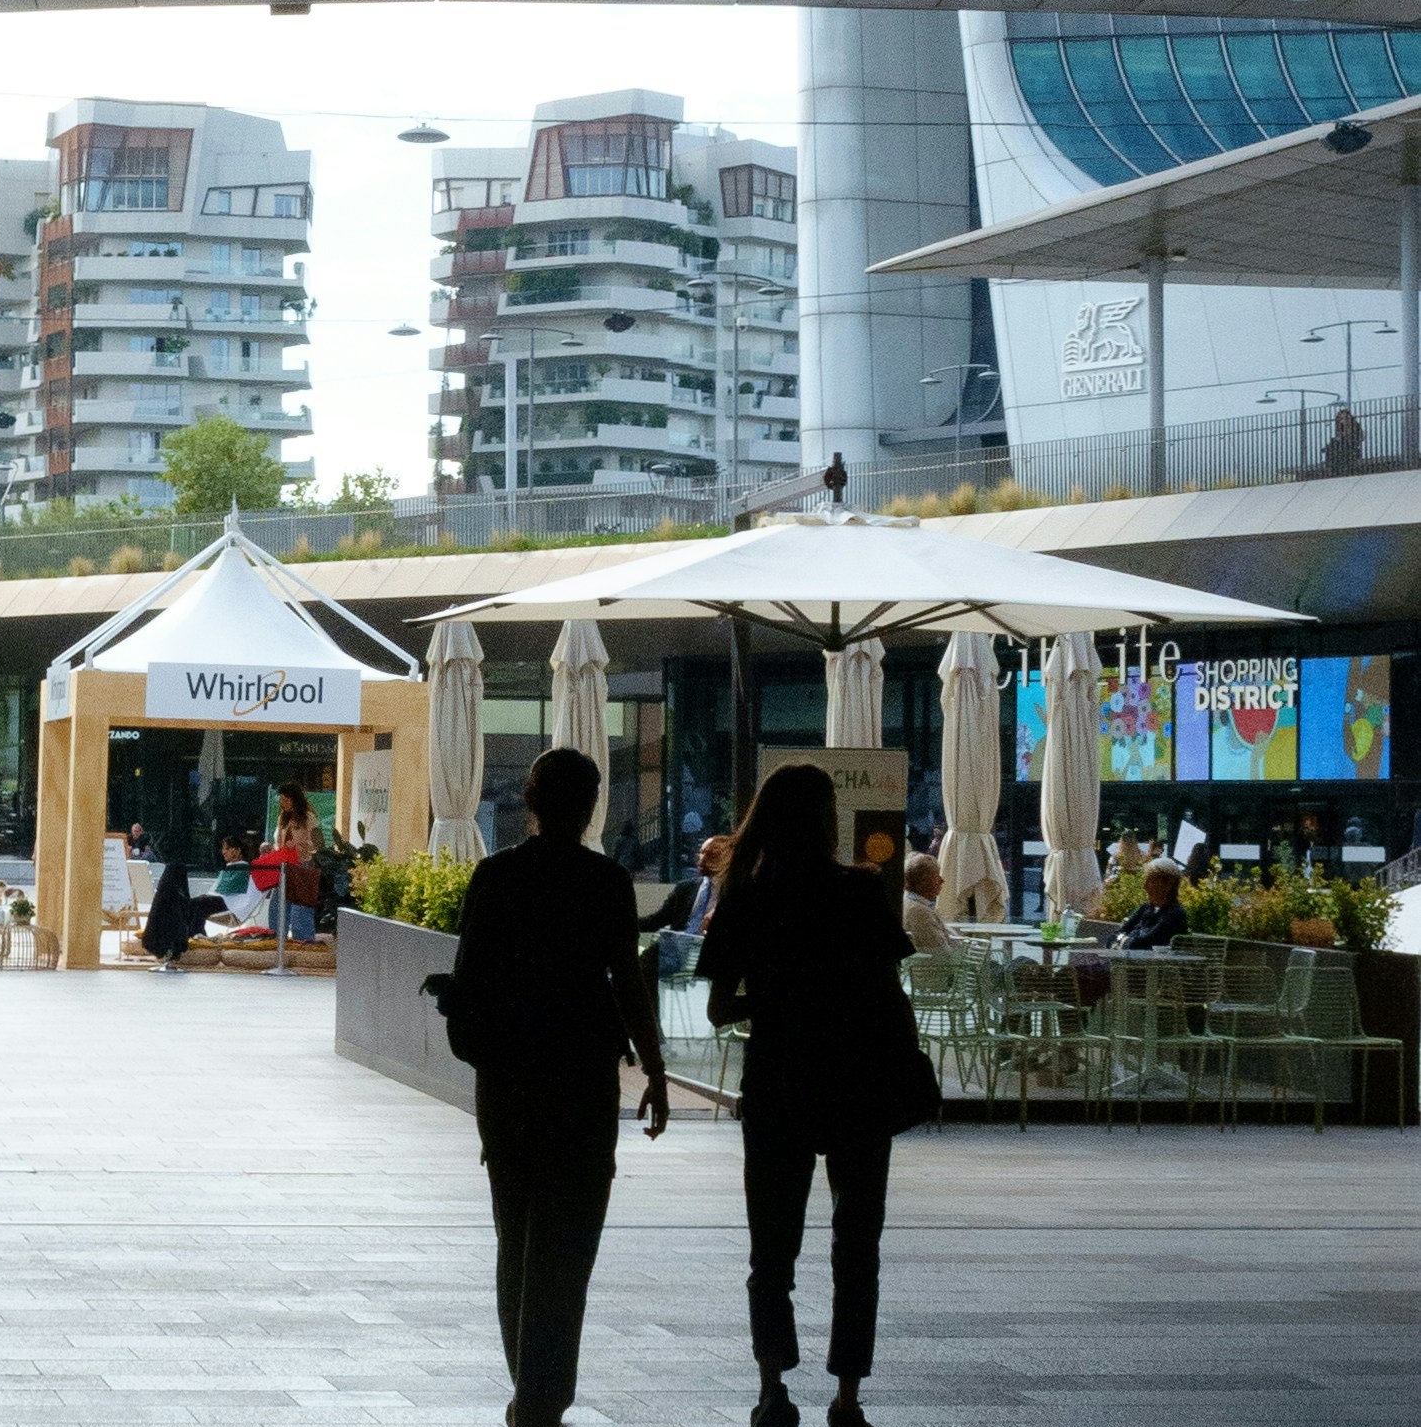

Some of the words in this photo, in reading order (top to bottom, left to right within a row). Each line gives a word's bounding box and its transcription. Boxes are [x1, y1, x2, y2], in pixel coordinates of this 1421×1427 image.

[1061, 369, 1144, 397] GENERALI
[1195, 657, 1298, 688] SHOPPING
[186, 672, 323, 710] Whirlpool
[1194, 683, 1298, 711] DISTRICT
[107, 730, 140, 740] ZANDO
[833, 769, 871, 789] CHA
